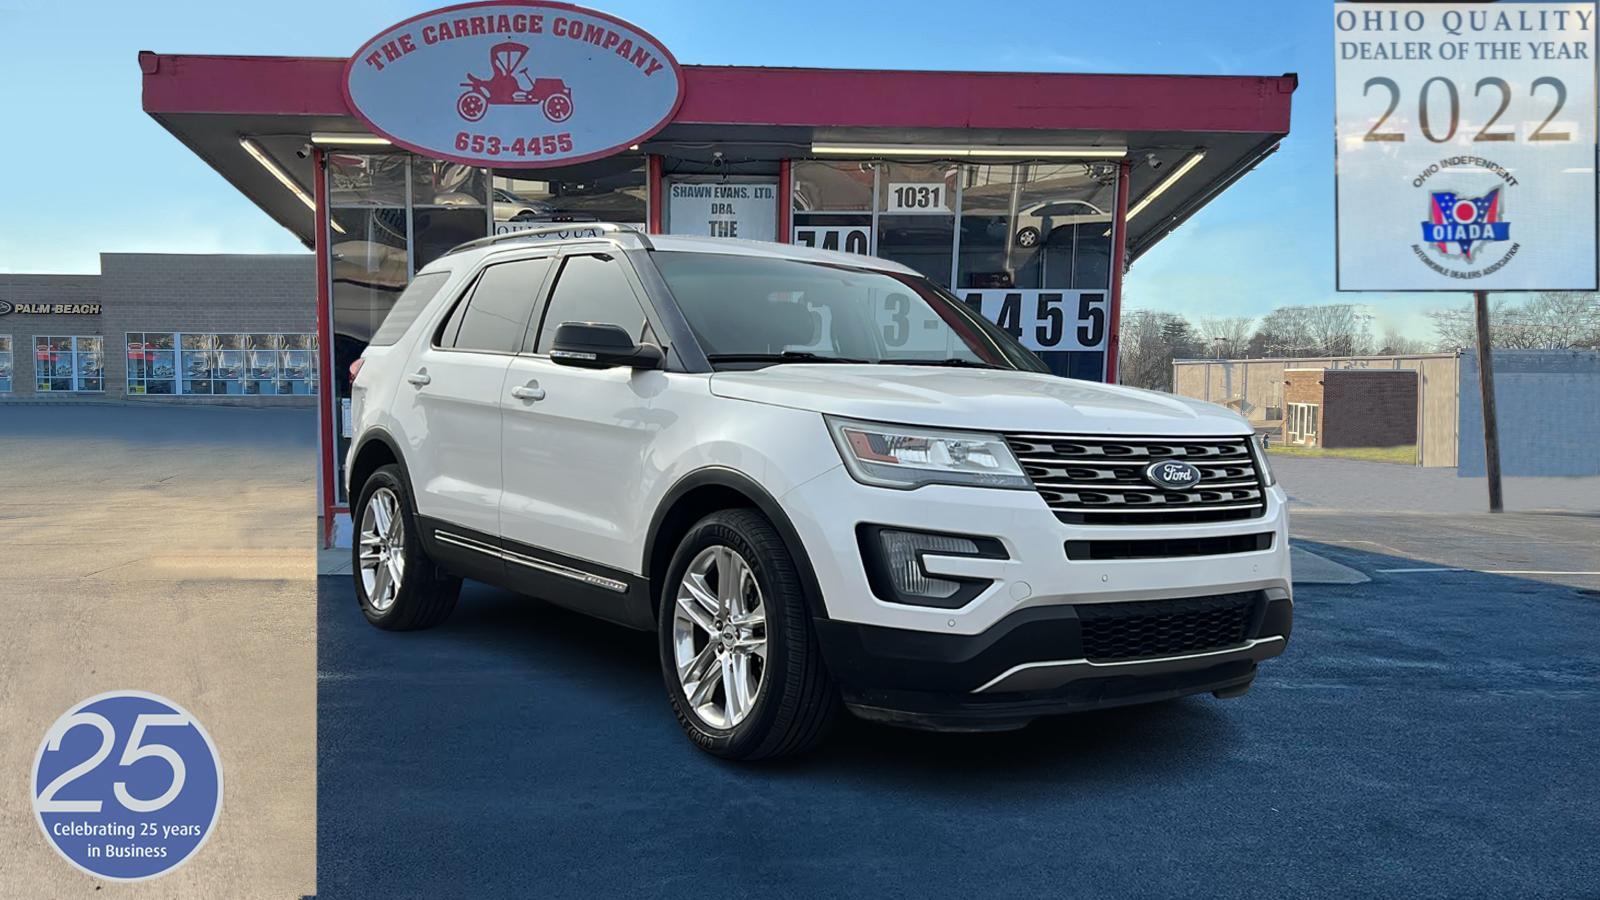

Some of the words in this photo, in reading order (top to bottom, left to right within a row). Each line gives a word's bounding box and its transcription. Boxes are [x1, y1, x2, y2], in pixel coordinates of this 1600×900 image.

[1336, 10, 1425, 31] OHIO
[1441, 10, 1592, 36] QUALITY
[365, 33, 417, 72] THE
[422, 14, 544, 46] CARRIAGE
[552, 16, 665, 77] COMPANY
[1340, 42, 1433, 60] DEALER
[1438, 42, 1469, 60] OF
[1475, 42, 1521, 60] THE
[1528, 41, 1589, 60] YEAR
[1362, 76, 1571, 144] 2022
[454, 131, 573, 157] 653-4455
[1412, 163, 1440, 189] OHIO
[1440, 155, 1519, 188] INDEPENDENT
[672, 185, 711, 198] SHAWN
[894, 186, 940, 208] 1031
[711, 203, 736, 215] DBA.
[708, 220, 738, 238] THE
[1432, 225, 1495, 240] OIADA
[1411, 244, 1450, 277] AUTOMOBILE
[1449, 270, 1482, 279] DEALERS
[1482, 242, 1521, 276] ASSOCIATION
[14, 303, 51, 314] PALM
[54, 303, 100, 314] BEACH
[1163, 464, 1193, 481] Ford
